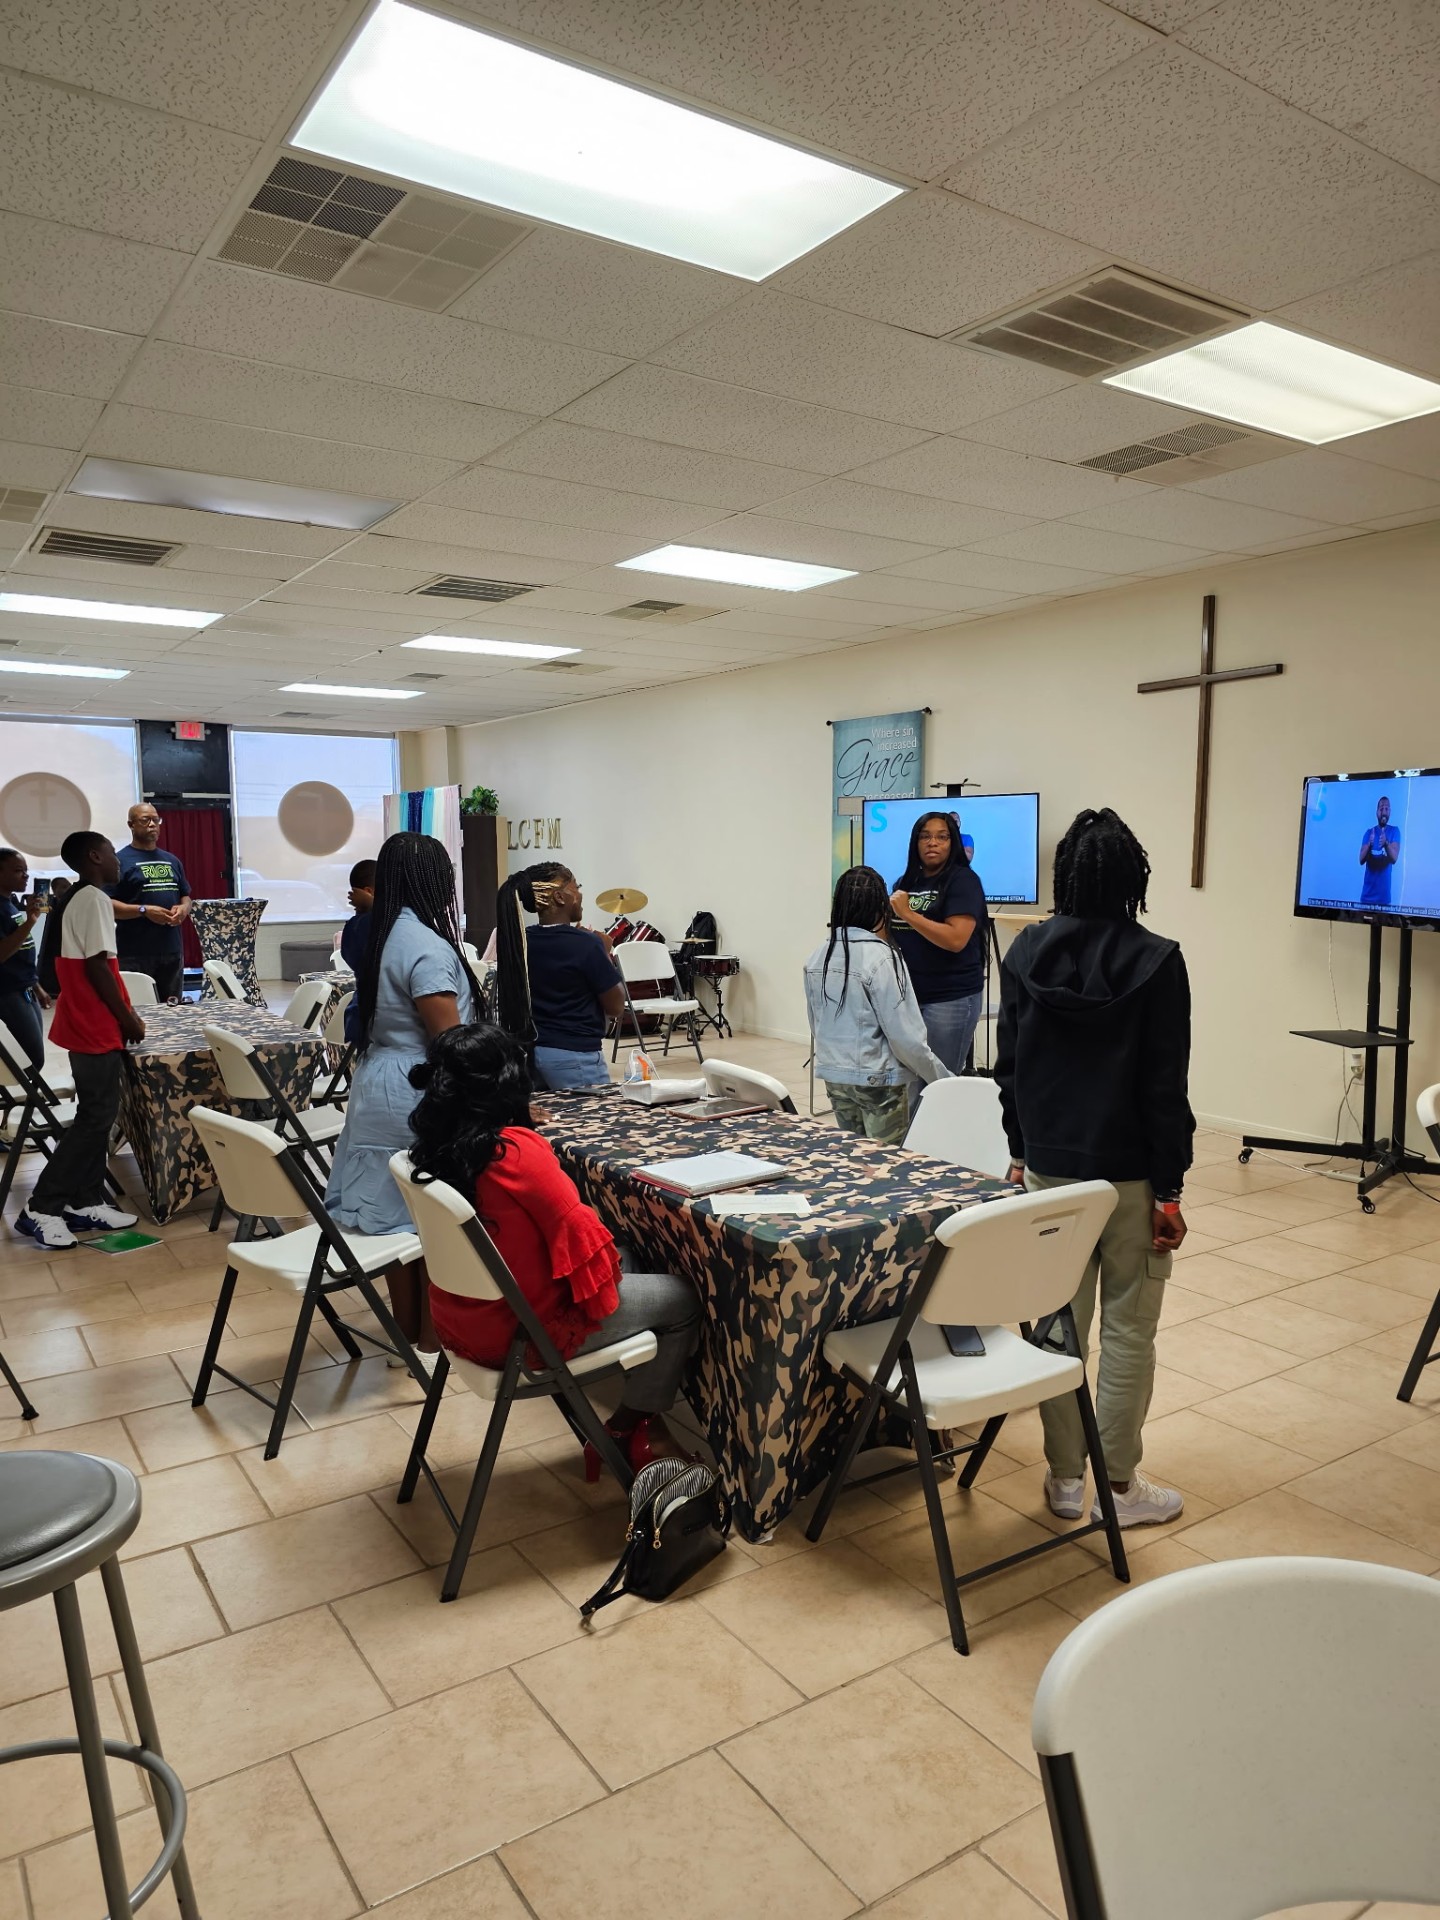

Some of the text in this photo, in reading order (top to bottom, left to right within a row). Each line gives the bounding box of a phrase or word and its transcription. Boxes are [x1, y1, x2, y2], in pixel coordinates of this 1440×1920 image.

[872, 727, 914, 738] Where sin
[877, 737, 917, 751] increased
[837, 739, 919, 796] Grace
[870, 803, 888, 832] S
[507, 818, 563, 850] LCFM
[140, 864, 174, 878] RIOT
